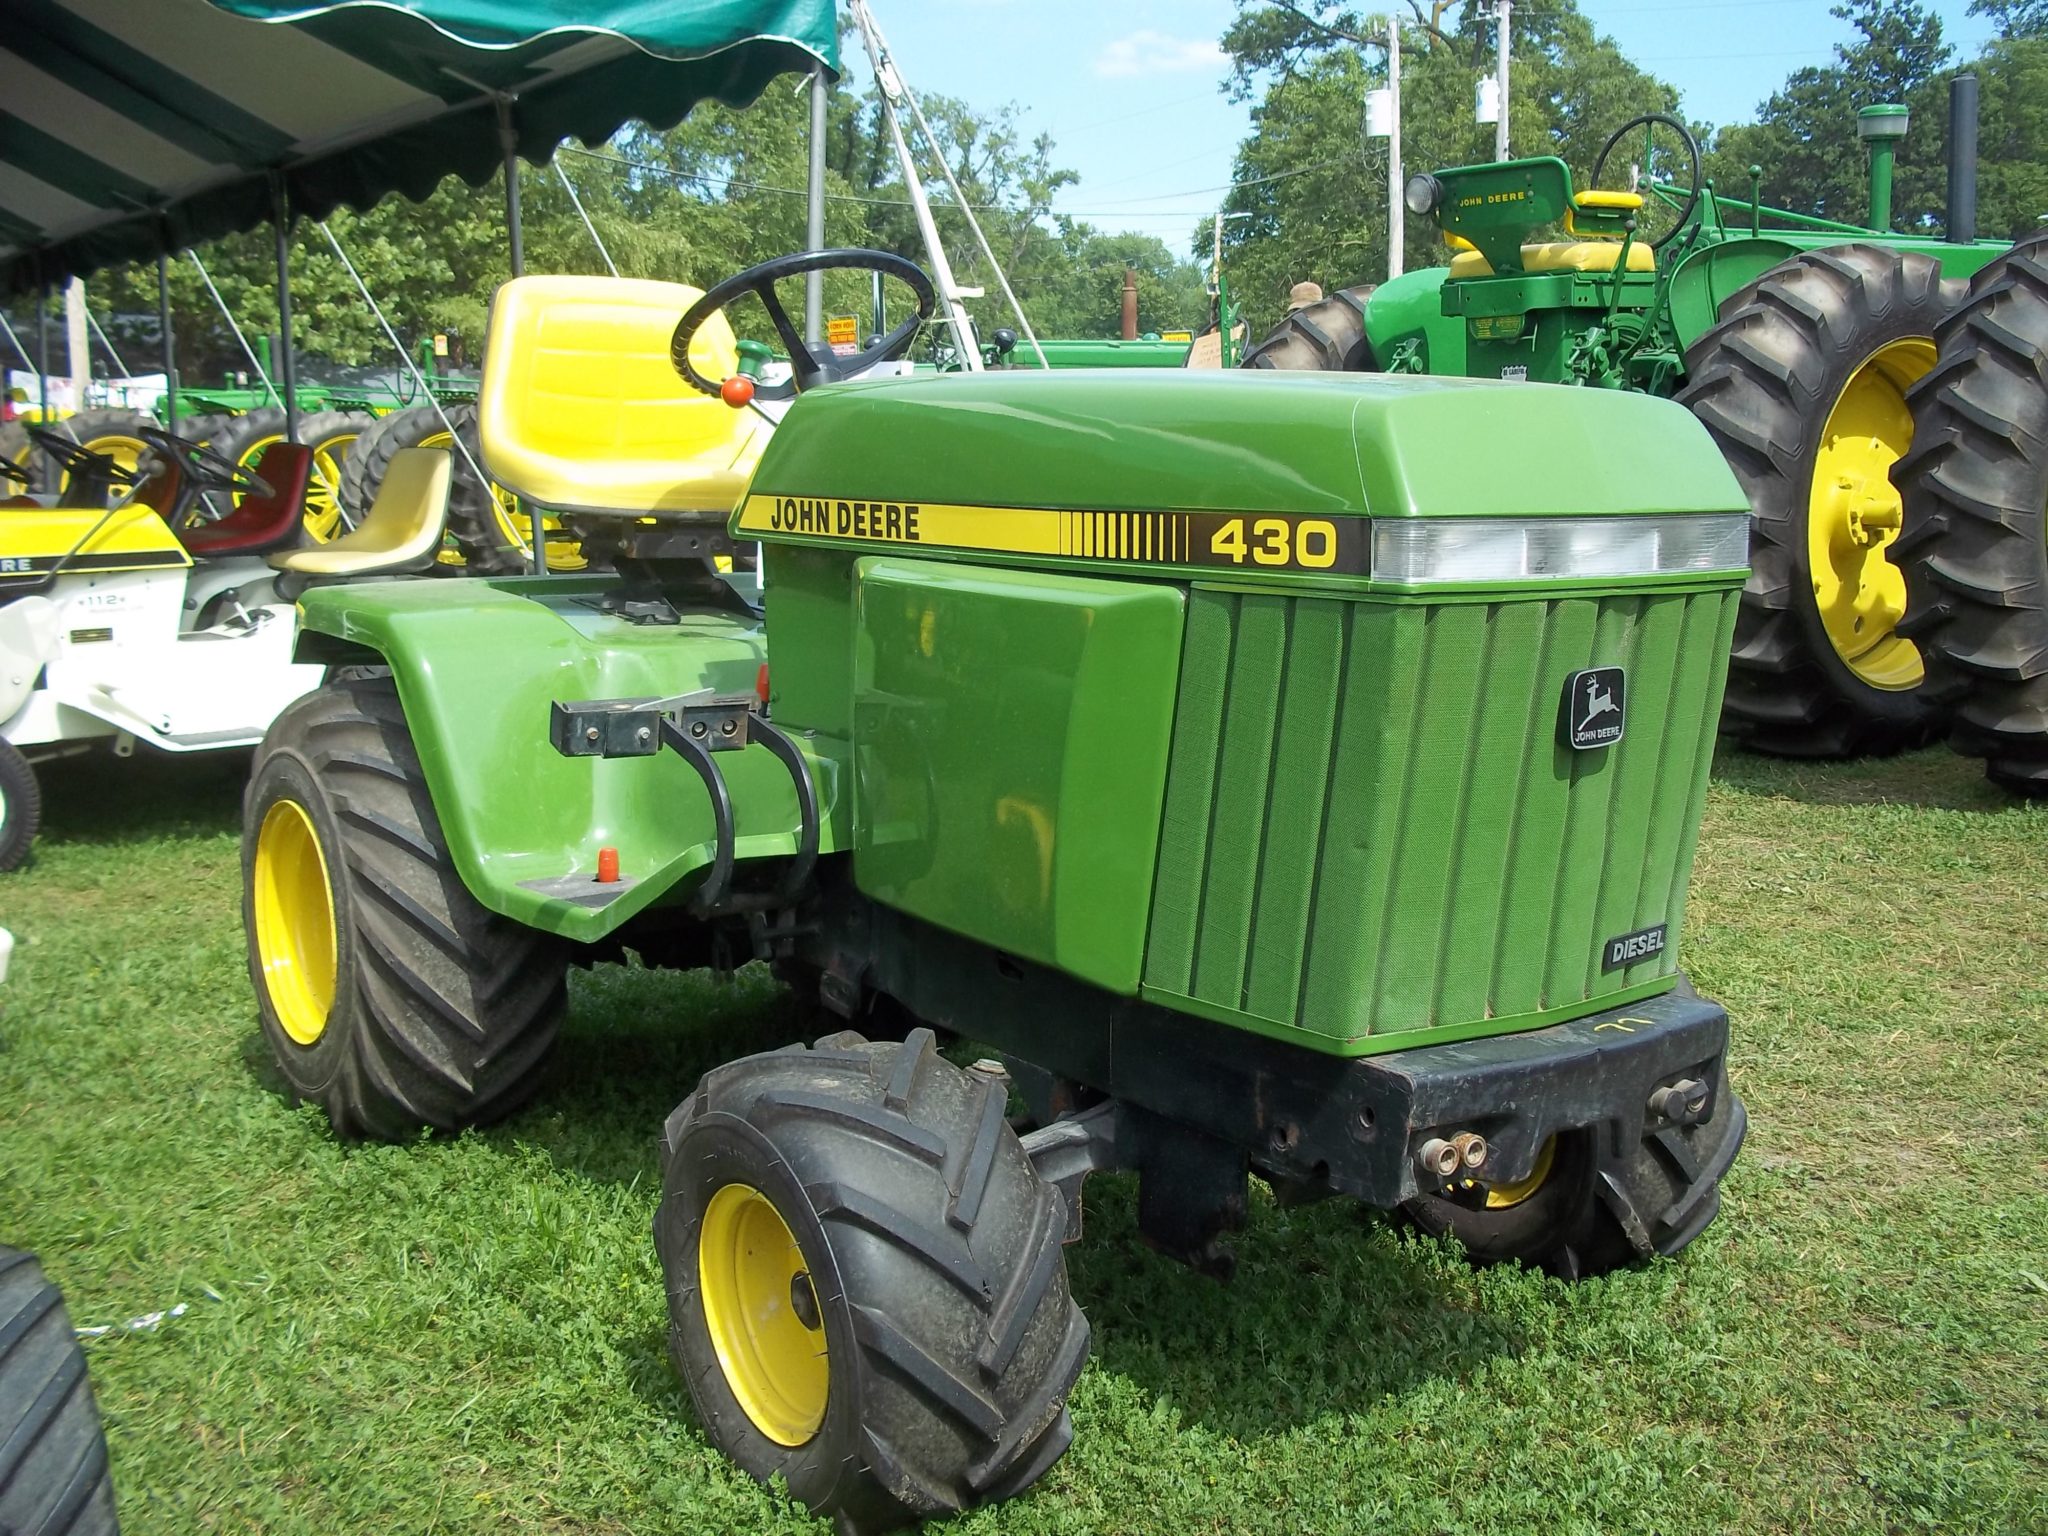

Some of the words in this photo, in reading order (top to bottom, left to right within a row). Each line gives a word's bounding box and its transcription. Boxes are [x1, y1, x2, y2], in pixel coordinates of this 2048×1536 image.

[1459, 197, 1482, 207] JOHN
[1488, 191, 1525, 204] DEERE
[771, 498, 830, 533] JOHN
[837, 502, 919, 541] DEERE
[1211, 518, 1337, 568] 430
[88, 595, 117, 605] 112
[1575, 730, 1596, 742] JOHN
[1597, 726, 1620, 739] DEERE
[1612, 930, 1664, 963] DIESEL
